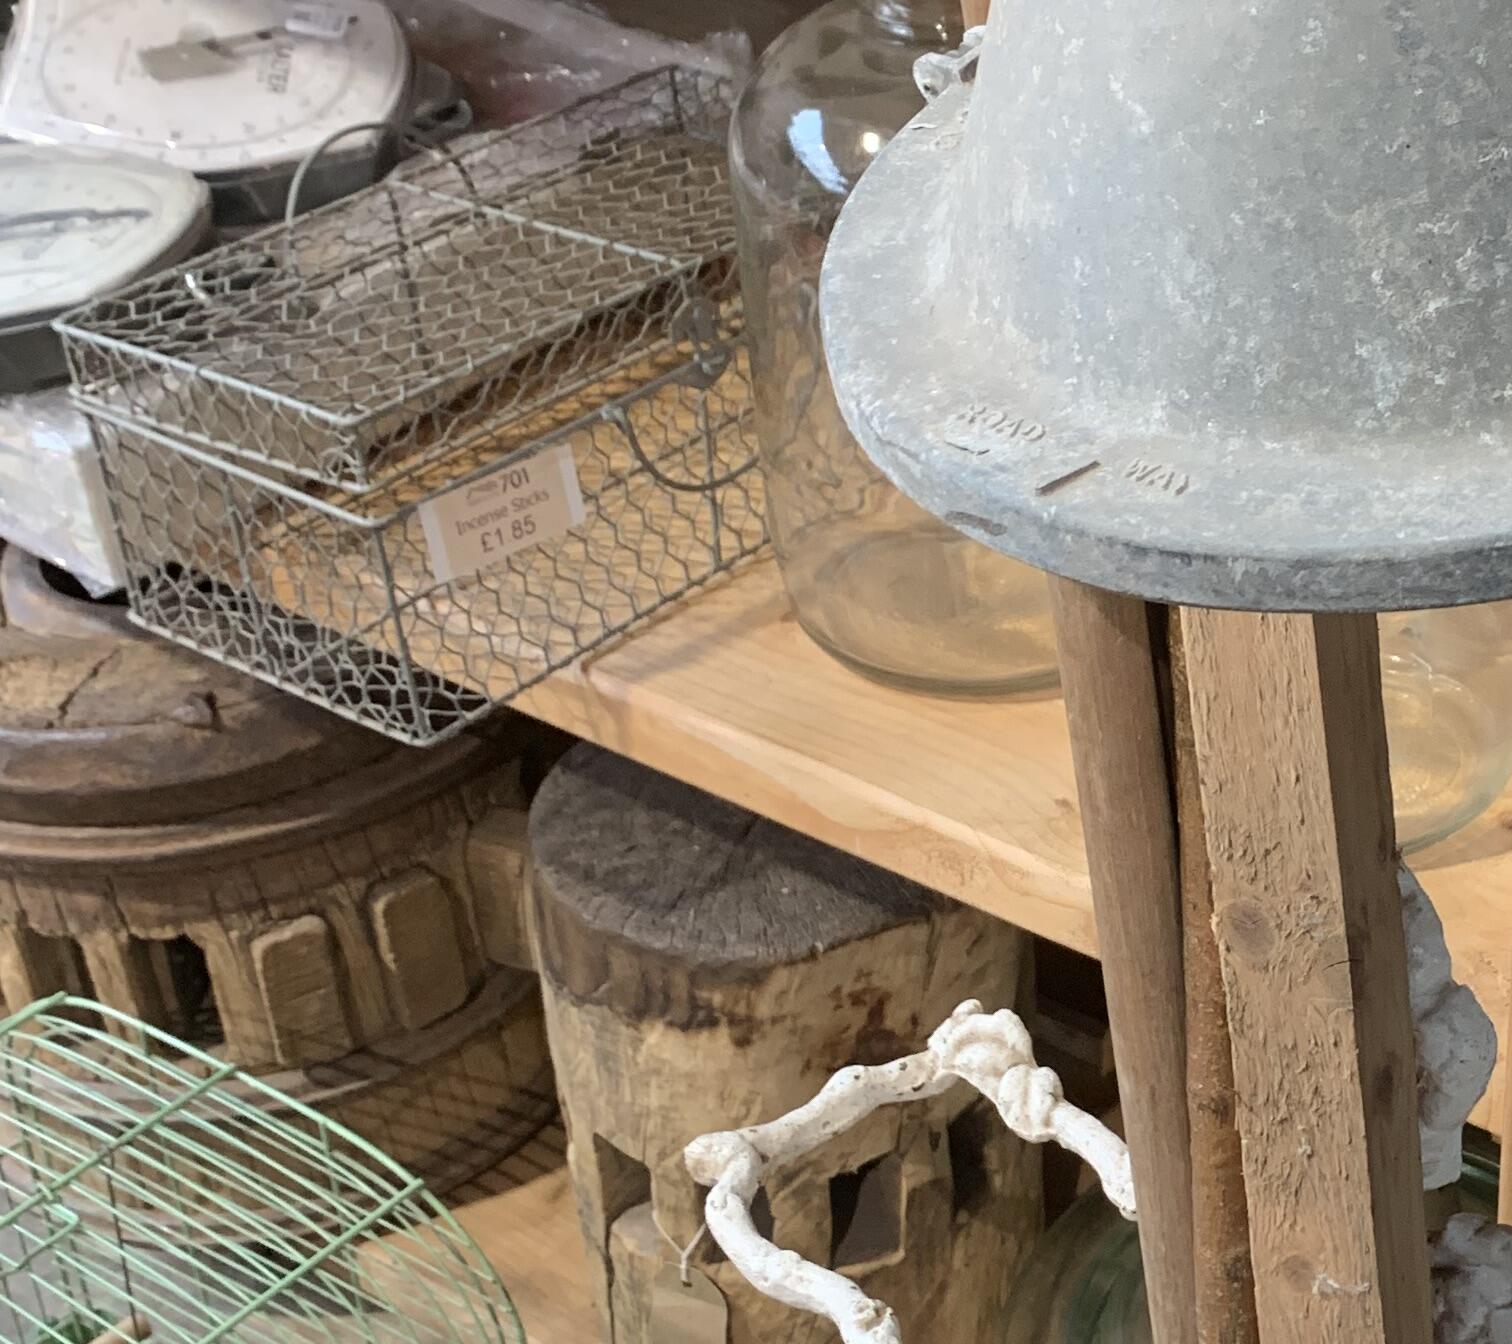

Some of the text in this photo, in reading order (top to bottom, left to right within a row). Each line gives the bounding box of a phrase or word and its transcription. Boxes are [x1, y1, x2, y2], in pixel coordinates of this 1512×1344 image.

[501, 467, 530, 494] 701
[455, 505, 509, 536] Incense
[510, 490, 550, 513] Sticks
